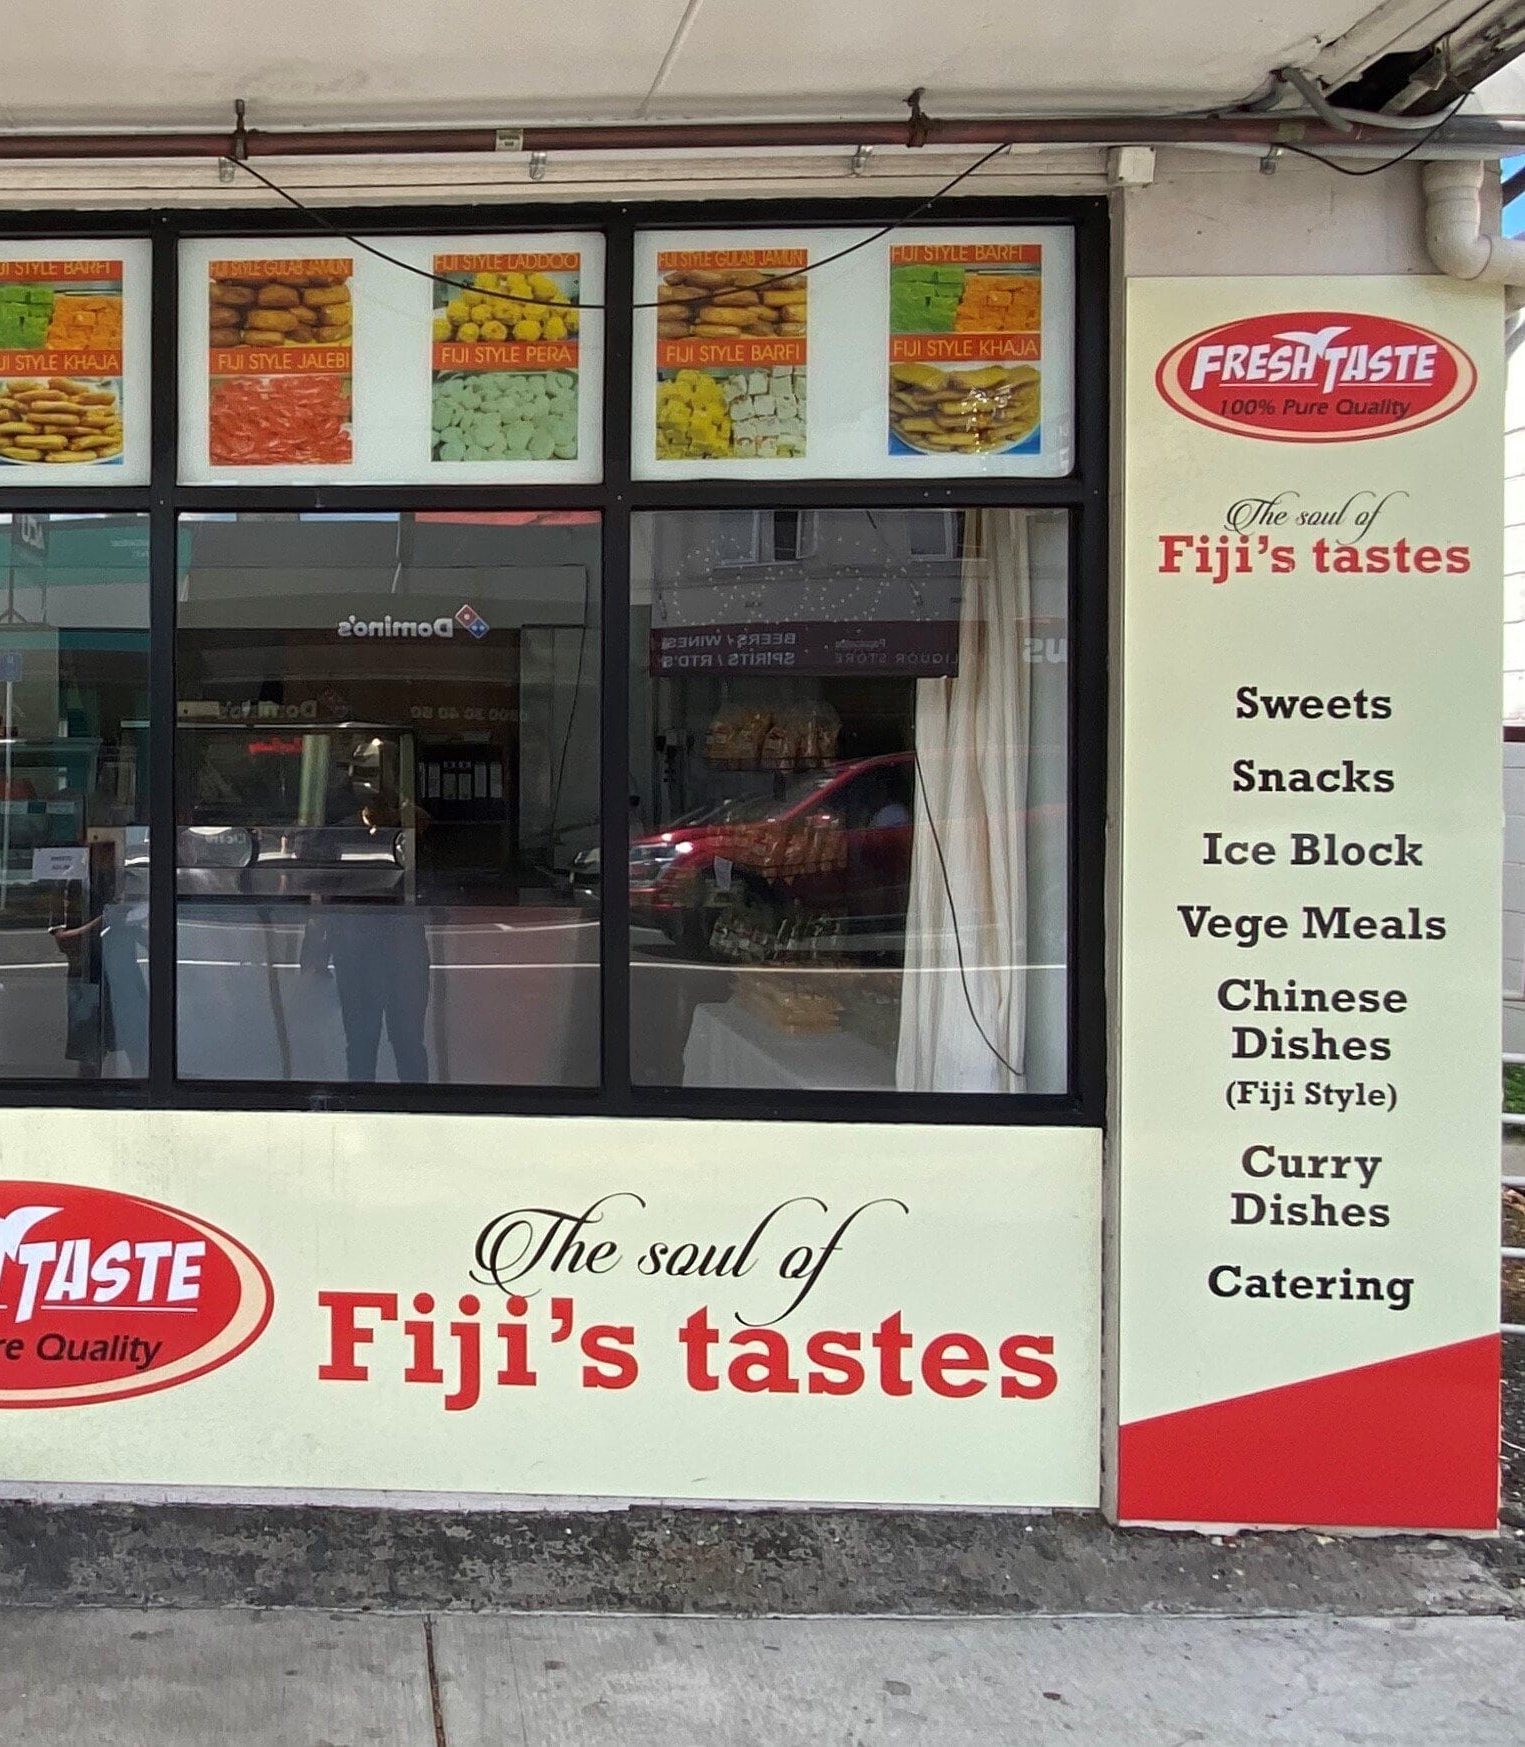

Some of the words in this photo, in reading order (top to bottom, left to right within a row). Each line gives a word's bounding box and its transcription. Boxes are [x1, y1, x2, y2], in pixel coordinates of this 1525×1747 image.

[15, 261, 58, 275] STYLE
[463, 254, 503, 270] STYLE
[508, 253, 578, 269] LADDOO
[892, 245, 917, 261] FIJI
[924, 245, 968, 260] STYLE
[976, 244, 1022, 260] BARFI
[15, 355, 58, 370] STYLE
[64, 354, 119, 370] KHAJA
[217, 353, 243, 370] FIJI
[249, 353, 292, 369] STYLE
[297, 352, 349, 369] JALEBI
[442, 347, 469, 363] FIJI
[475, 346, 520, 363] STYLE
[526, 346, 572, 361] PERA
[666, 345, 693, 362] FIJI
[700, 345, 744, 361] STYLE
[751, 344, 799, 360] BARFI
[894, 340, 921, 357] FIJI
[927, 340, 972, 356] STYLE
[979, 339, 1038, 356] KHAJA
[1189, 342, 1317, 391] FRESH
[1322, 343, 1438, 394] TASTE
[1219, 398, 1275, 416] 100%
[1283, 398, 1329, 416] Pure
[1336, 399, 1411, 420] Quality
[1224, 490, 1301, 535] The
[1295, 490, 1376, 526] soul
[1335, 490, 1410, 546] of
[1157, 534, 1296, 584] Fiji's
[1311, 536, 1471, 574] tastes
[1236, 686, 1392, 720] Sweets
[1232, 759, 1395, 793] Snacks
[1202, 832, 1276, 866] Ice
[1290, 833, 1423, 867] Block
[1176, 904, 1289, 948] Vege
[1302, 906, 1447, 940] Meals
[1217, 978, 1408, 1013] Chinese
[1231, 1026, 1392, 1061] Dishes
[1225, 1080, 1295, 1111] (Fiji
[1304, 1081, 1398, 1113] Style)
[1241, 1144, 1383, 1189] Curry
[1230, 1191, 1391, 1228] Dishes
[468, 1191, 646, 1298] The
[636, 1196, 828, 1280] soul
[733, 1196, 910, 1328] of
[13, 1236, 207, 1324] TASTE
[1207, 1264, 1414, 1311] Catering
[36, 1332, 164, 1370] Quality
[317, 1289, 639, 1411] Fiji's
[678, 1304, 1059, 1400] tastes
